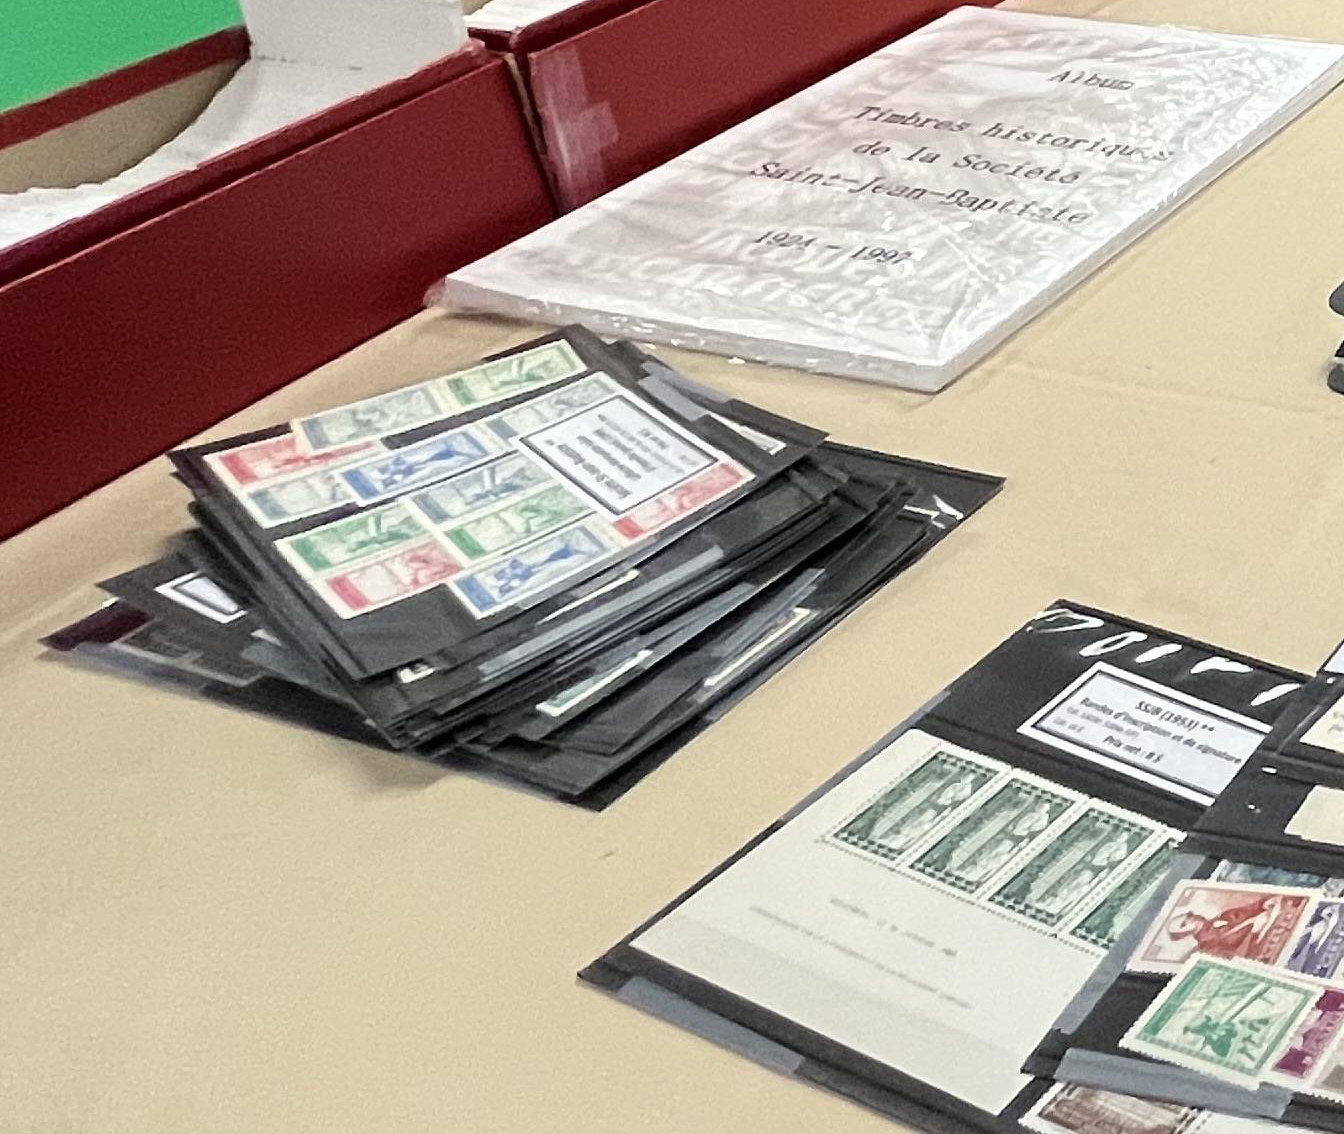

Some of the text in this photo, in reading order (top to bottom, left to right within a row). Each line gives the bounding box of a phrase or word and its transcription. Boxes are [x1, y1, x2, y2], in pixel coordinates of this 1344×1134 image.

[1049, 69, 1134, 91] Album
[854, 105, 970, 134] Timbres
[852, 139, 1081, 185] de la Société
[749, 161, 1092, 225] Saint-Jean-Baptiste
